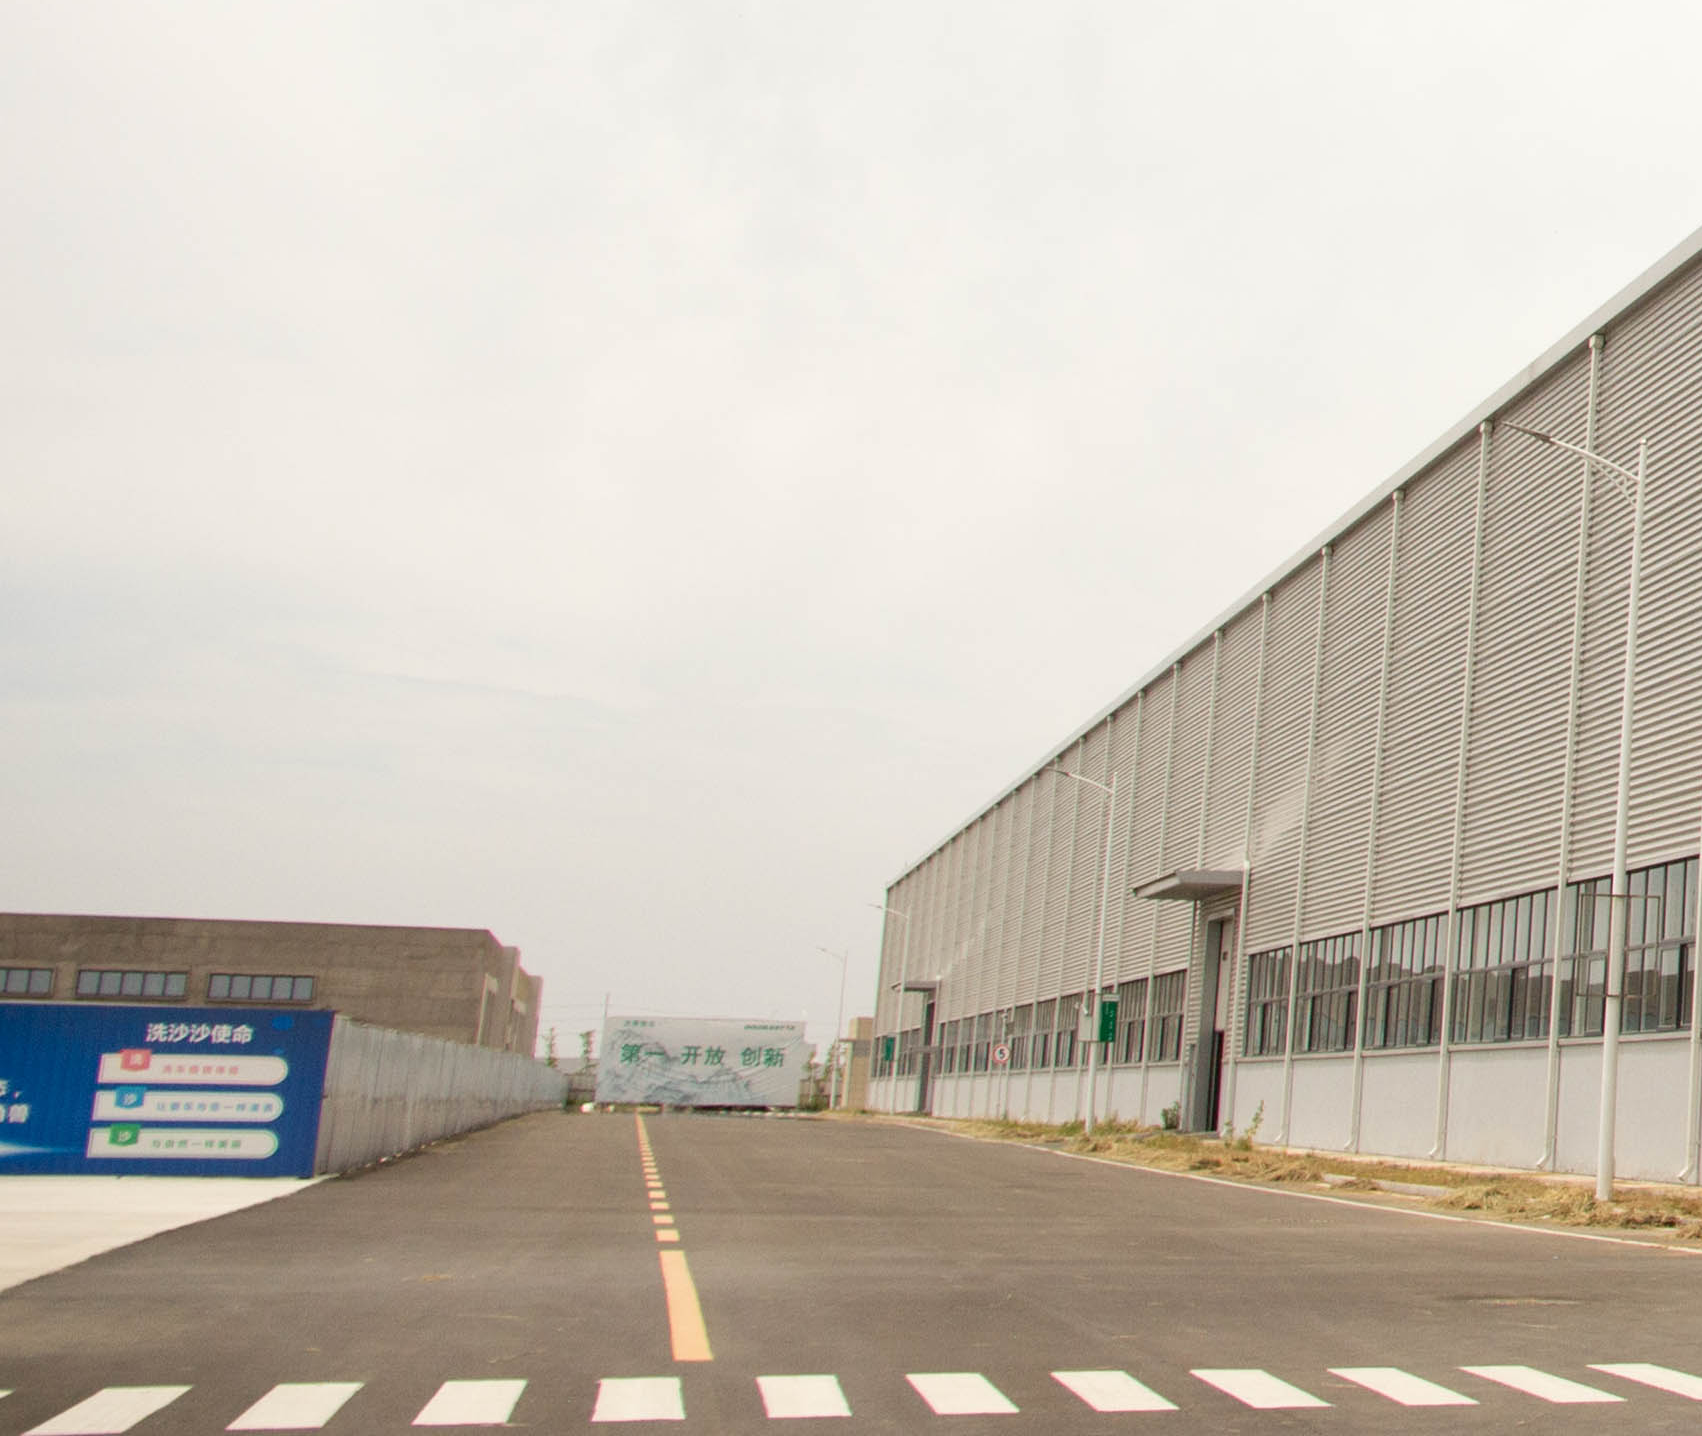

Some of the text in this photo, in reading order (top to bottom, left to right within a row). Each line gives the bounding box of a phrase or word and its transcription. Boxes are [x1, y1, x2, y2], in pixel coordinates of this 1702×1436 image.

[145, 1023, 253, 1044] 洗沙沙使命
[620, 1043, 785, 1068] 第一 开放 创新
